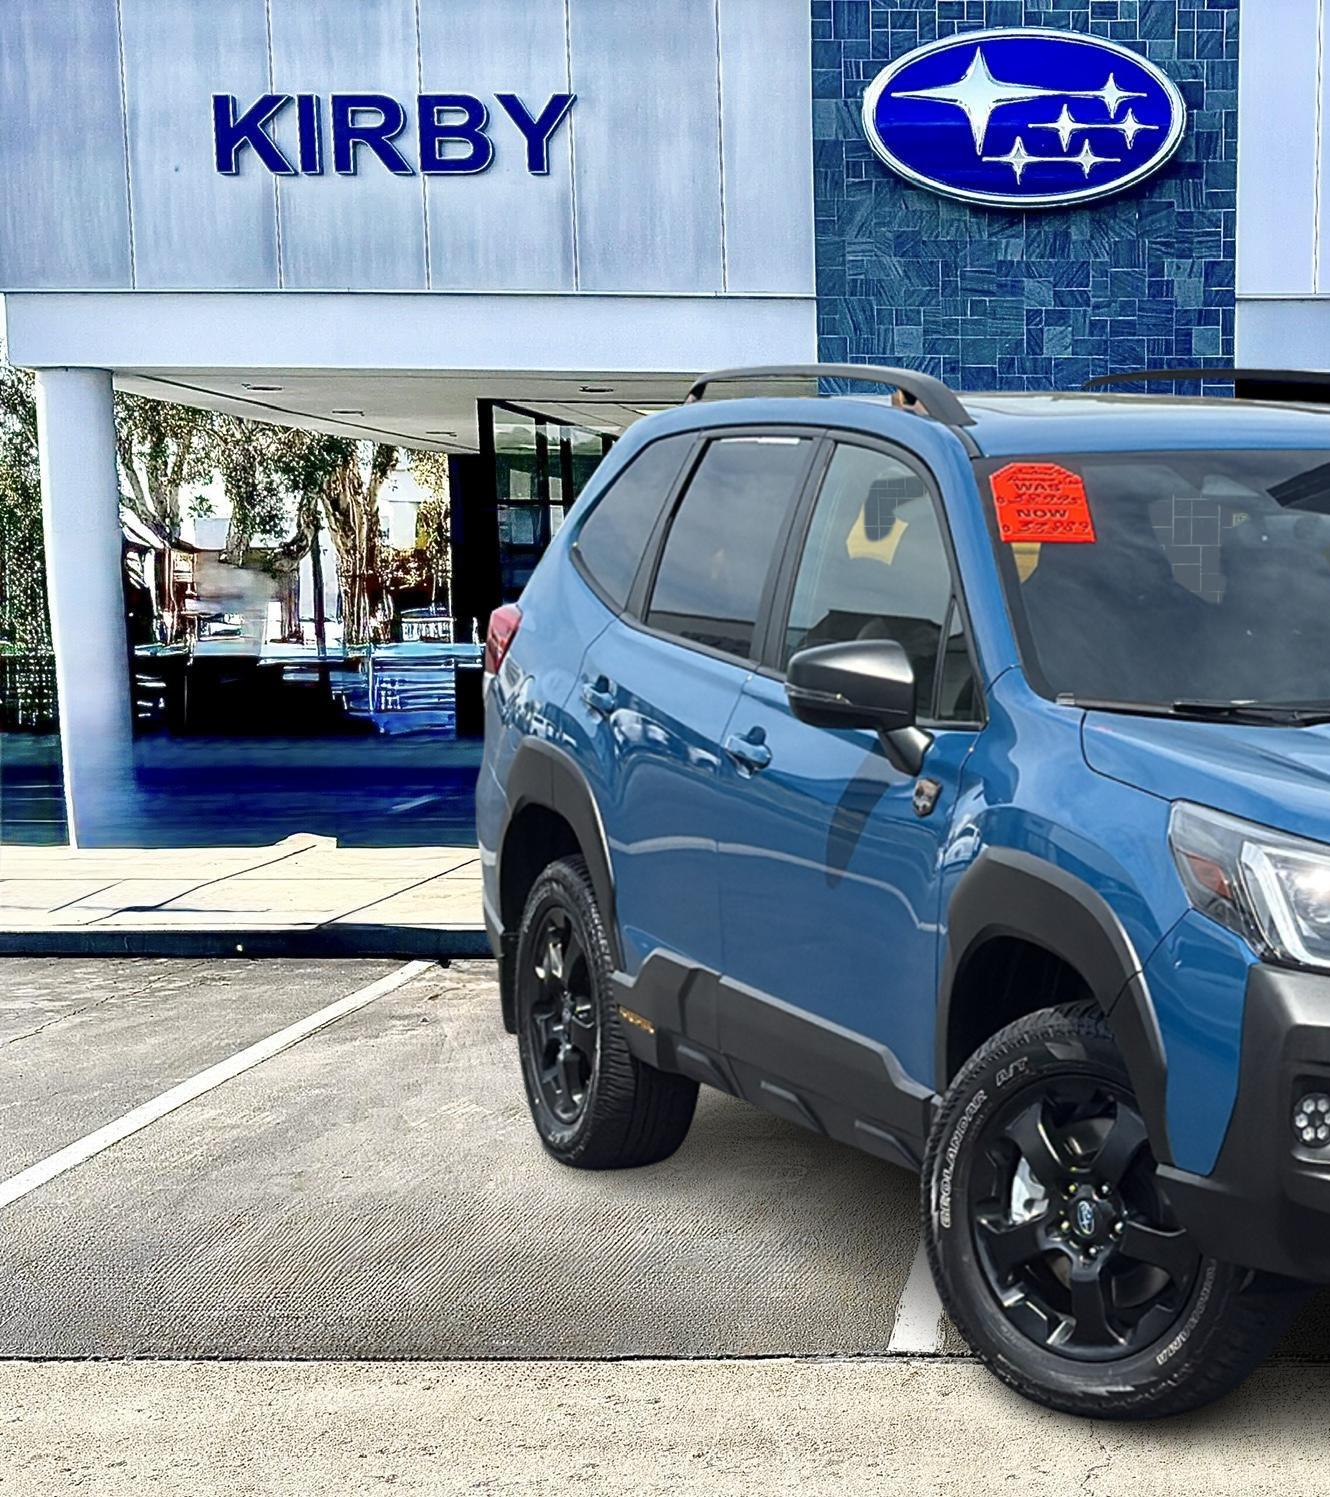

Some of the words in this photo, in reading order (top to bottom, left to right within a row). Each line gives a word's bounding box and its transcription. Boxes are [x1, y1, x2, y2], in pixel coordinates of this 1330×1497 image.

[212, 93, 577, 176] KIRBY
[1016, 509, 1067, 518] NOW
[939, 1089, 988, 1228] GEOLANDAR
